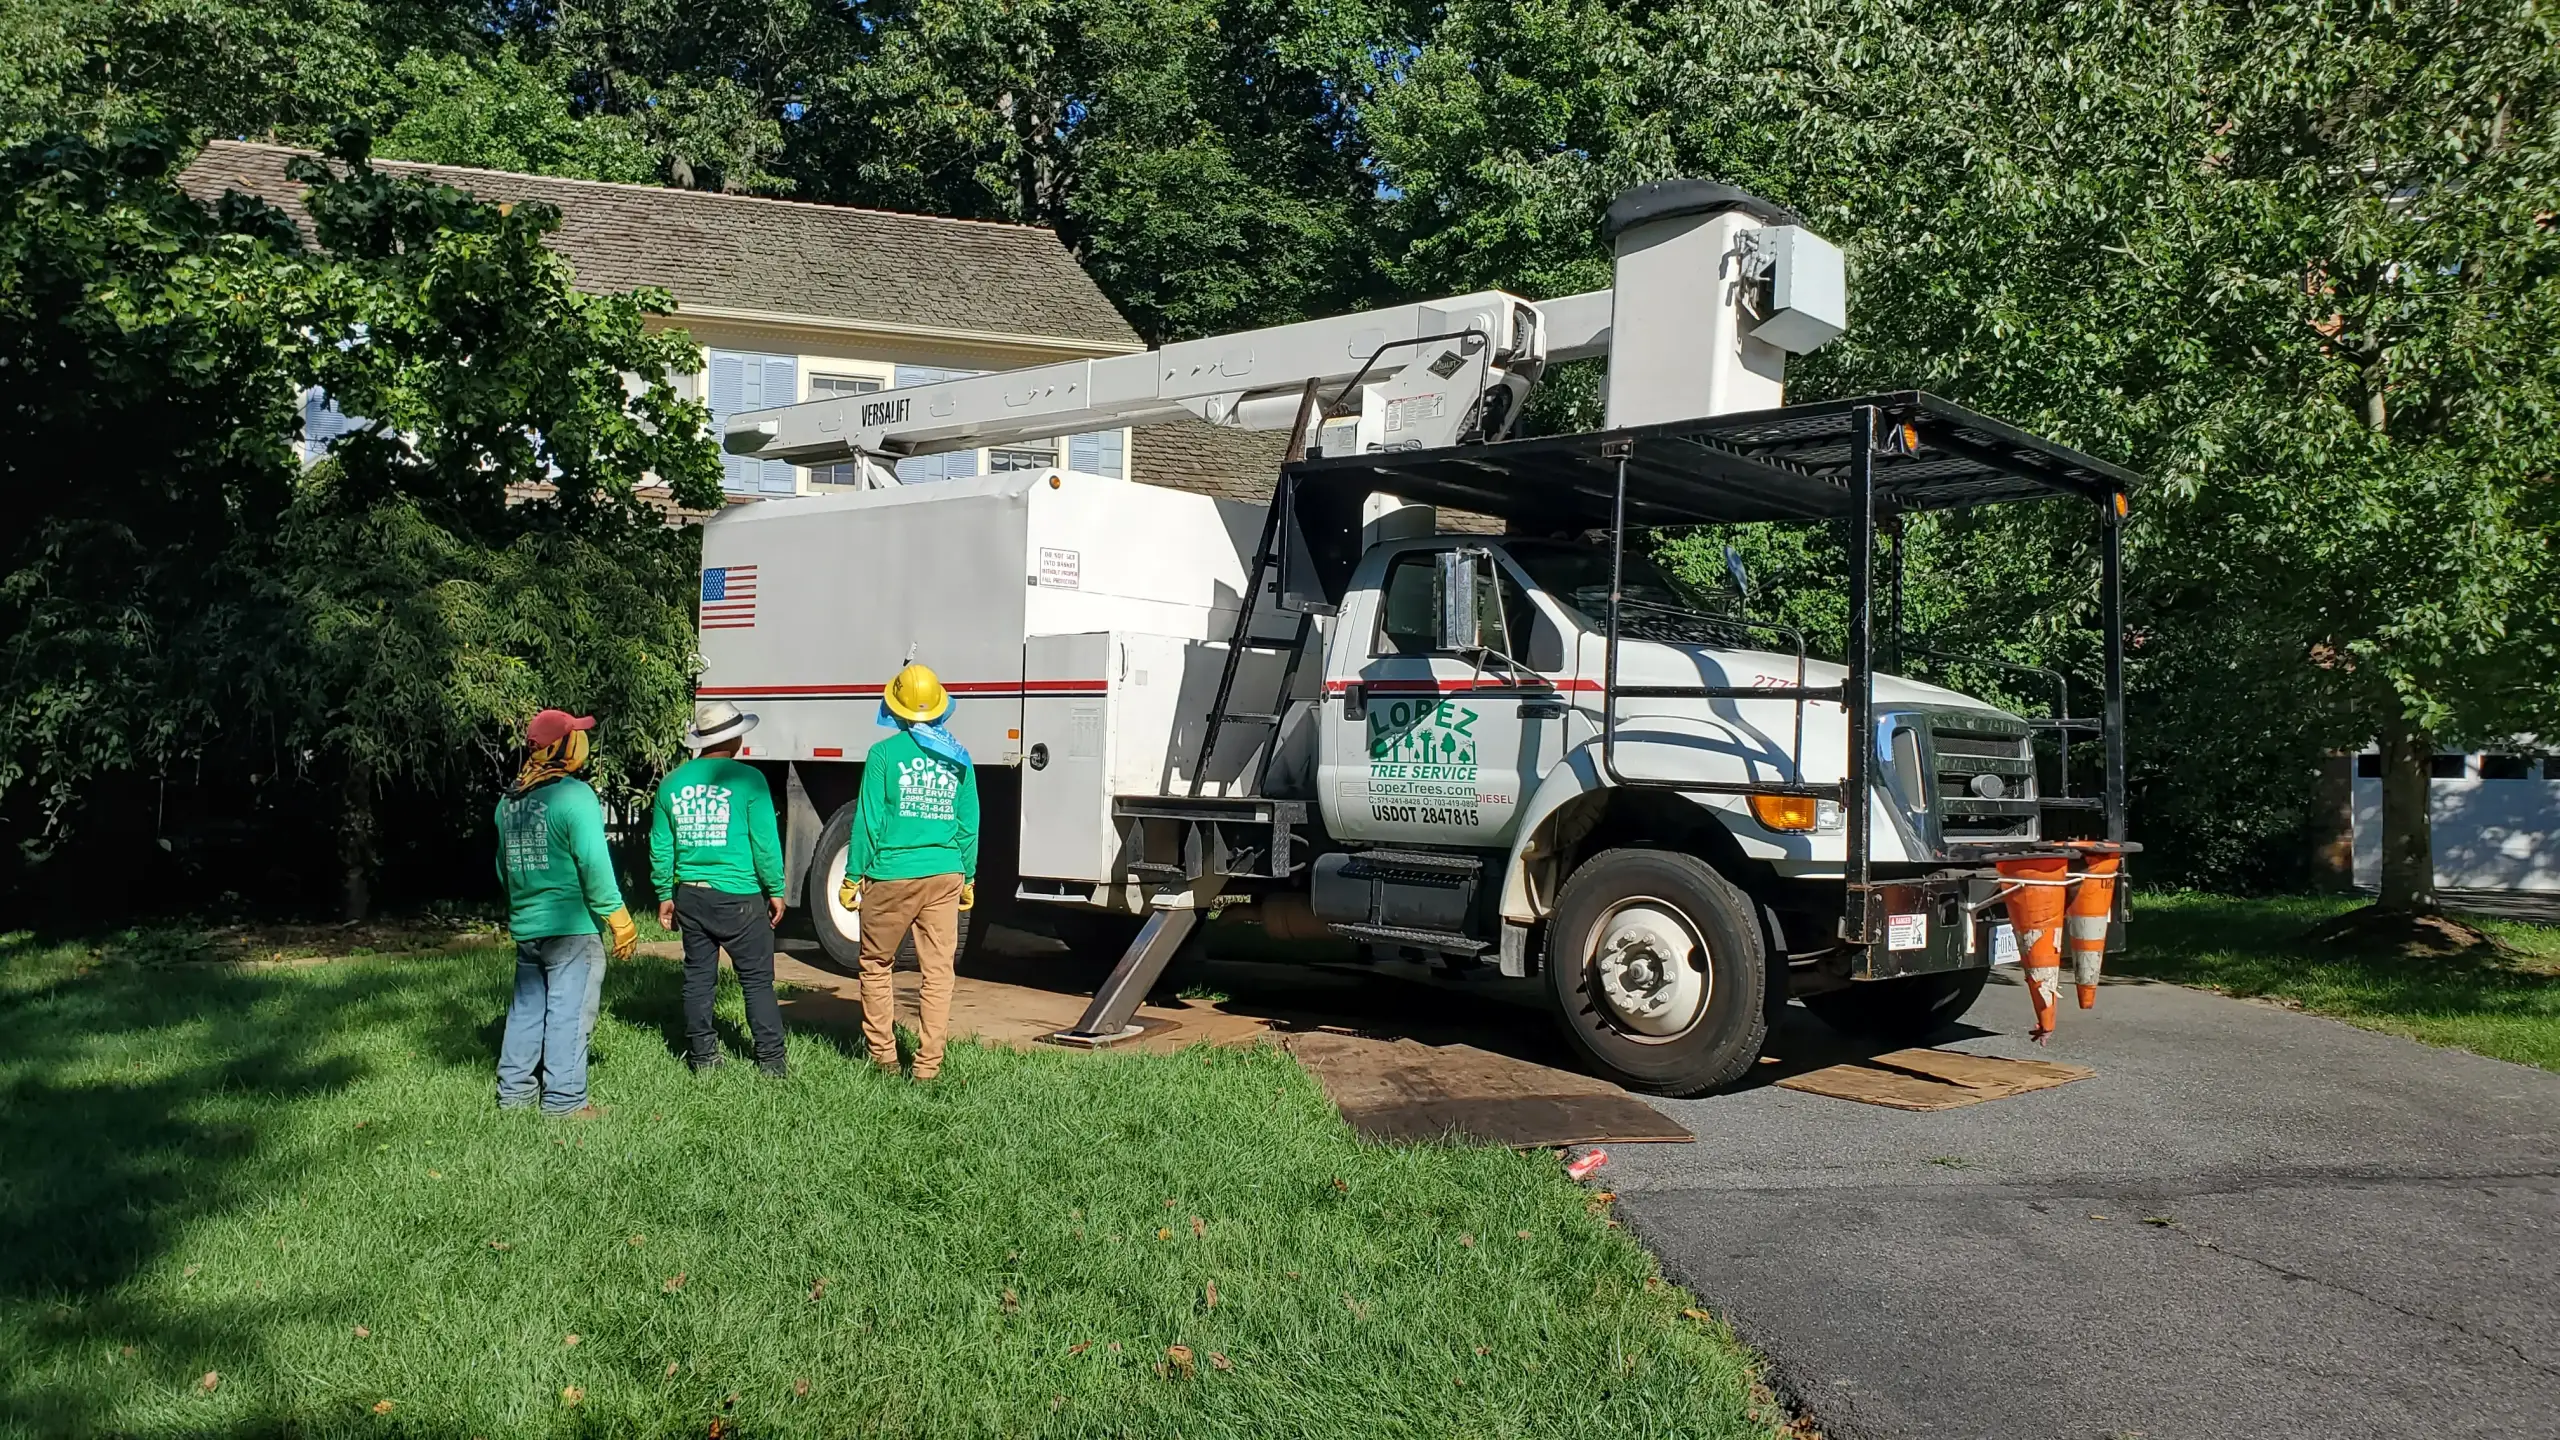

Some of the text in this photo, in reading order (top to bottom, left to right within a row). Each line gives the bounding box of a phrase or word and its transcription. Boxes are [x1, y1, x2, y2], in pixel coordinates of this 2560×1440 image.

[862, 399, 911, 427] VERSALIFT
[1369, 700, 1479, 738] LOPEZ
[898, 757, 959, 781] LOPEZ
[1371, 765, 1478, 780] TREE SERVICE
[670, 784, 731, 804] LOPEZ
[900, 787, 924, 795] TREE
[1368, 781, 1476, 796] LopezTrees.com
[1475, 794, 1514, 804] DIESEL
[1372, 805, 1479, 826] USDOT 2847815
